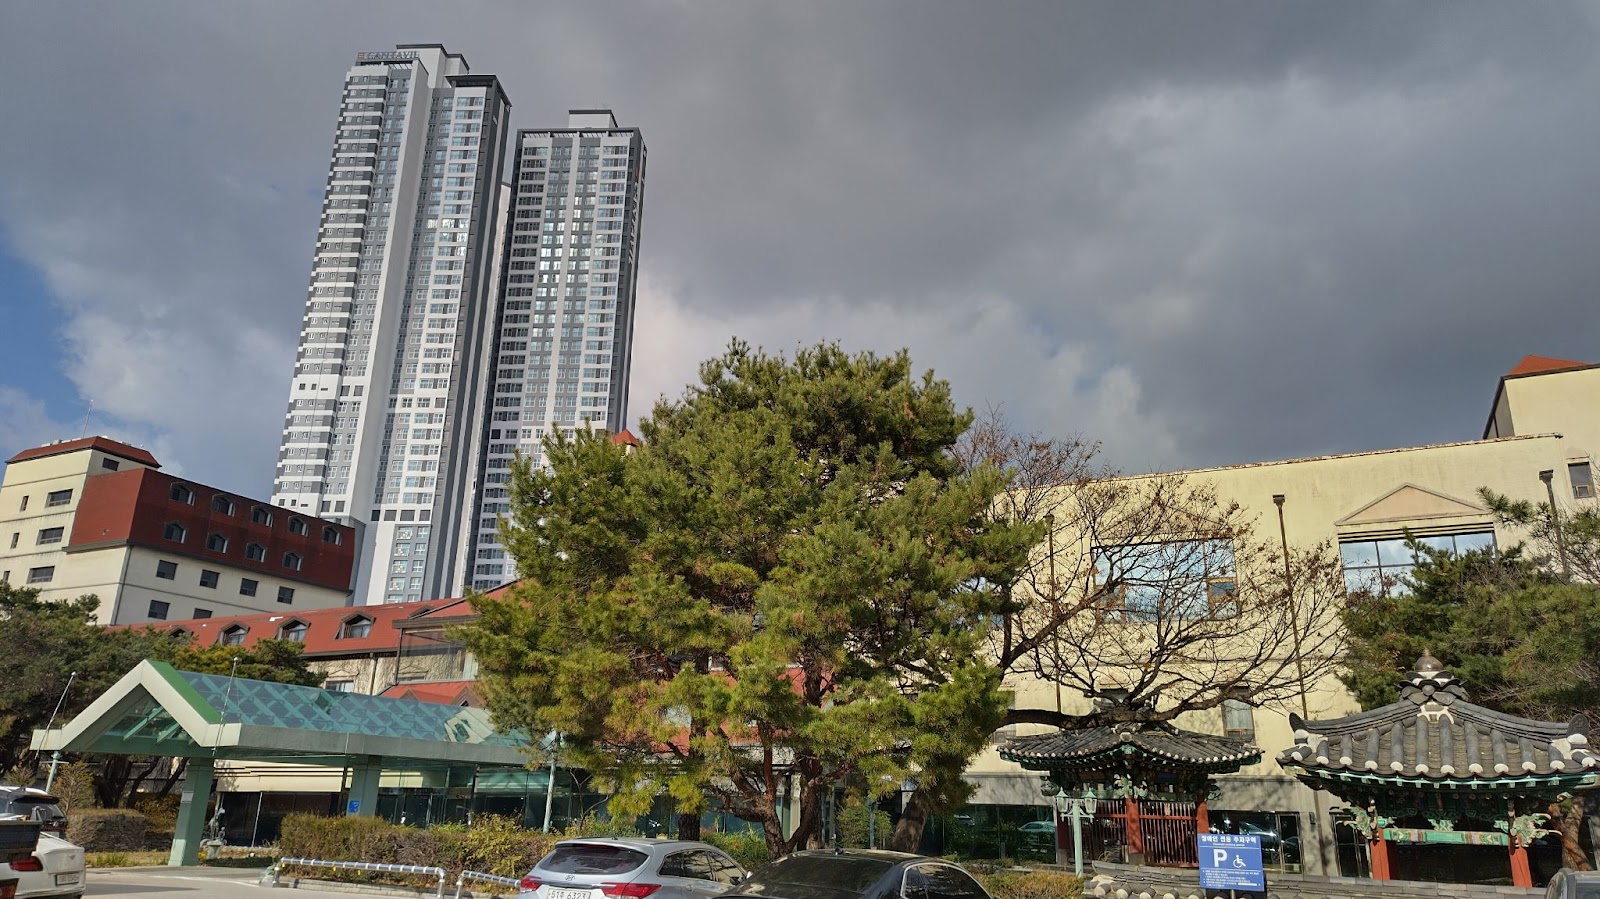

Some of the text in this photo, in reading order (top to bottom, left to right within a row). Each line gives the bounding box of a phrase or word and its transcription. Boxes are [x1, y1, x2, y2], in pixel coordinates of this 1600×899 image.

[368, 51, 420, 59] CANTAVIL
[1201, 835, 1218, 843] 장애인
[1233, 836, 1257, 844] 주차구역
[1213, 848, 1228, 867] P
